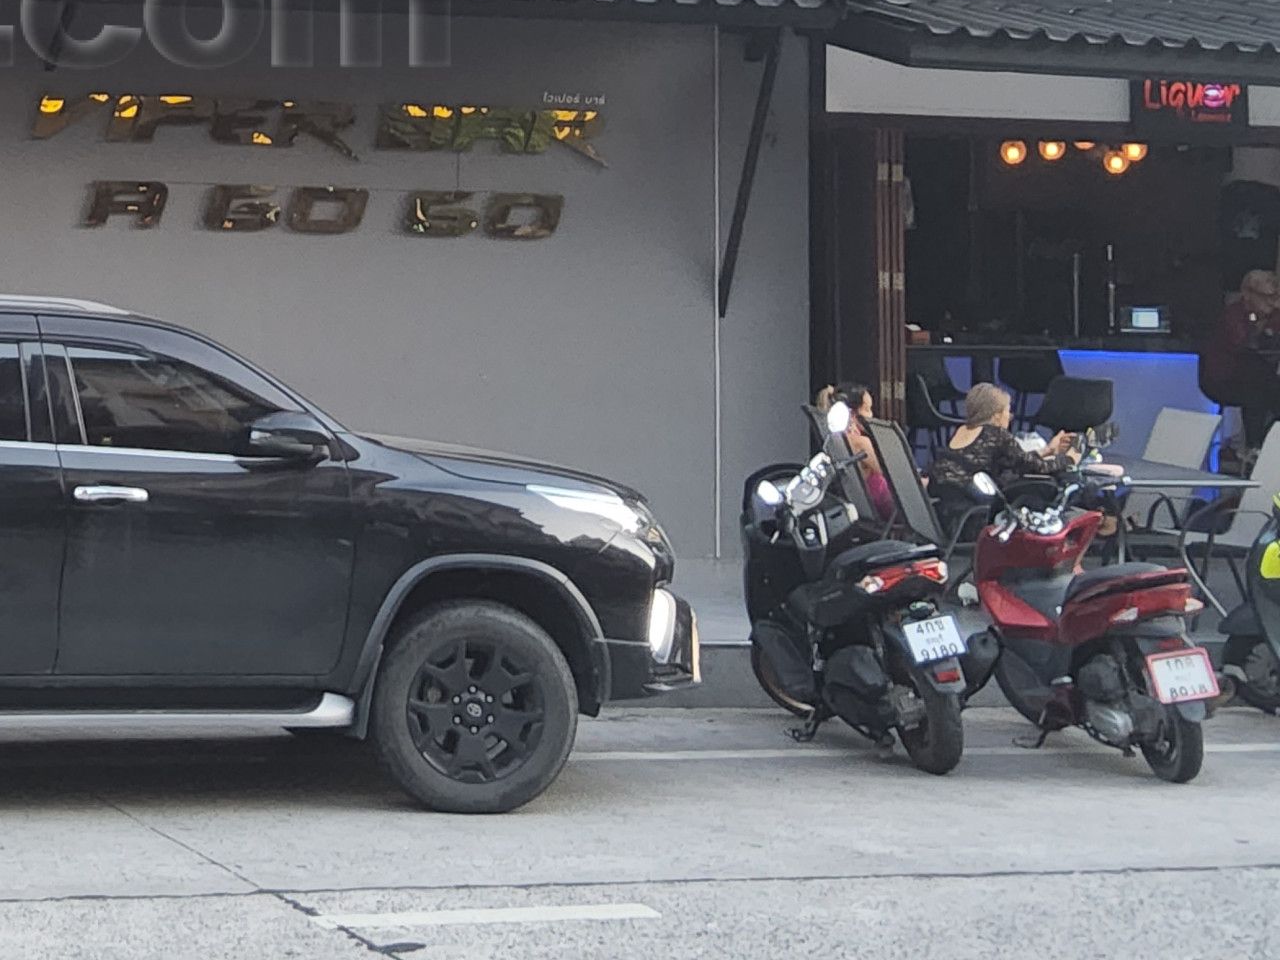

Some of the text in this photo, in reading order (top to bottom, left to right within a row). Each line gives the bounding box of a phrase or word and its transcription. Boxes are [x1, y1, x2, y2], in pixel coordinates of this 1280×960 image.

[32, 93, 608, 168] VIPER BAR
[84, 180, 169, 231] A
